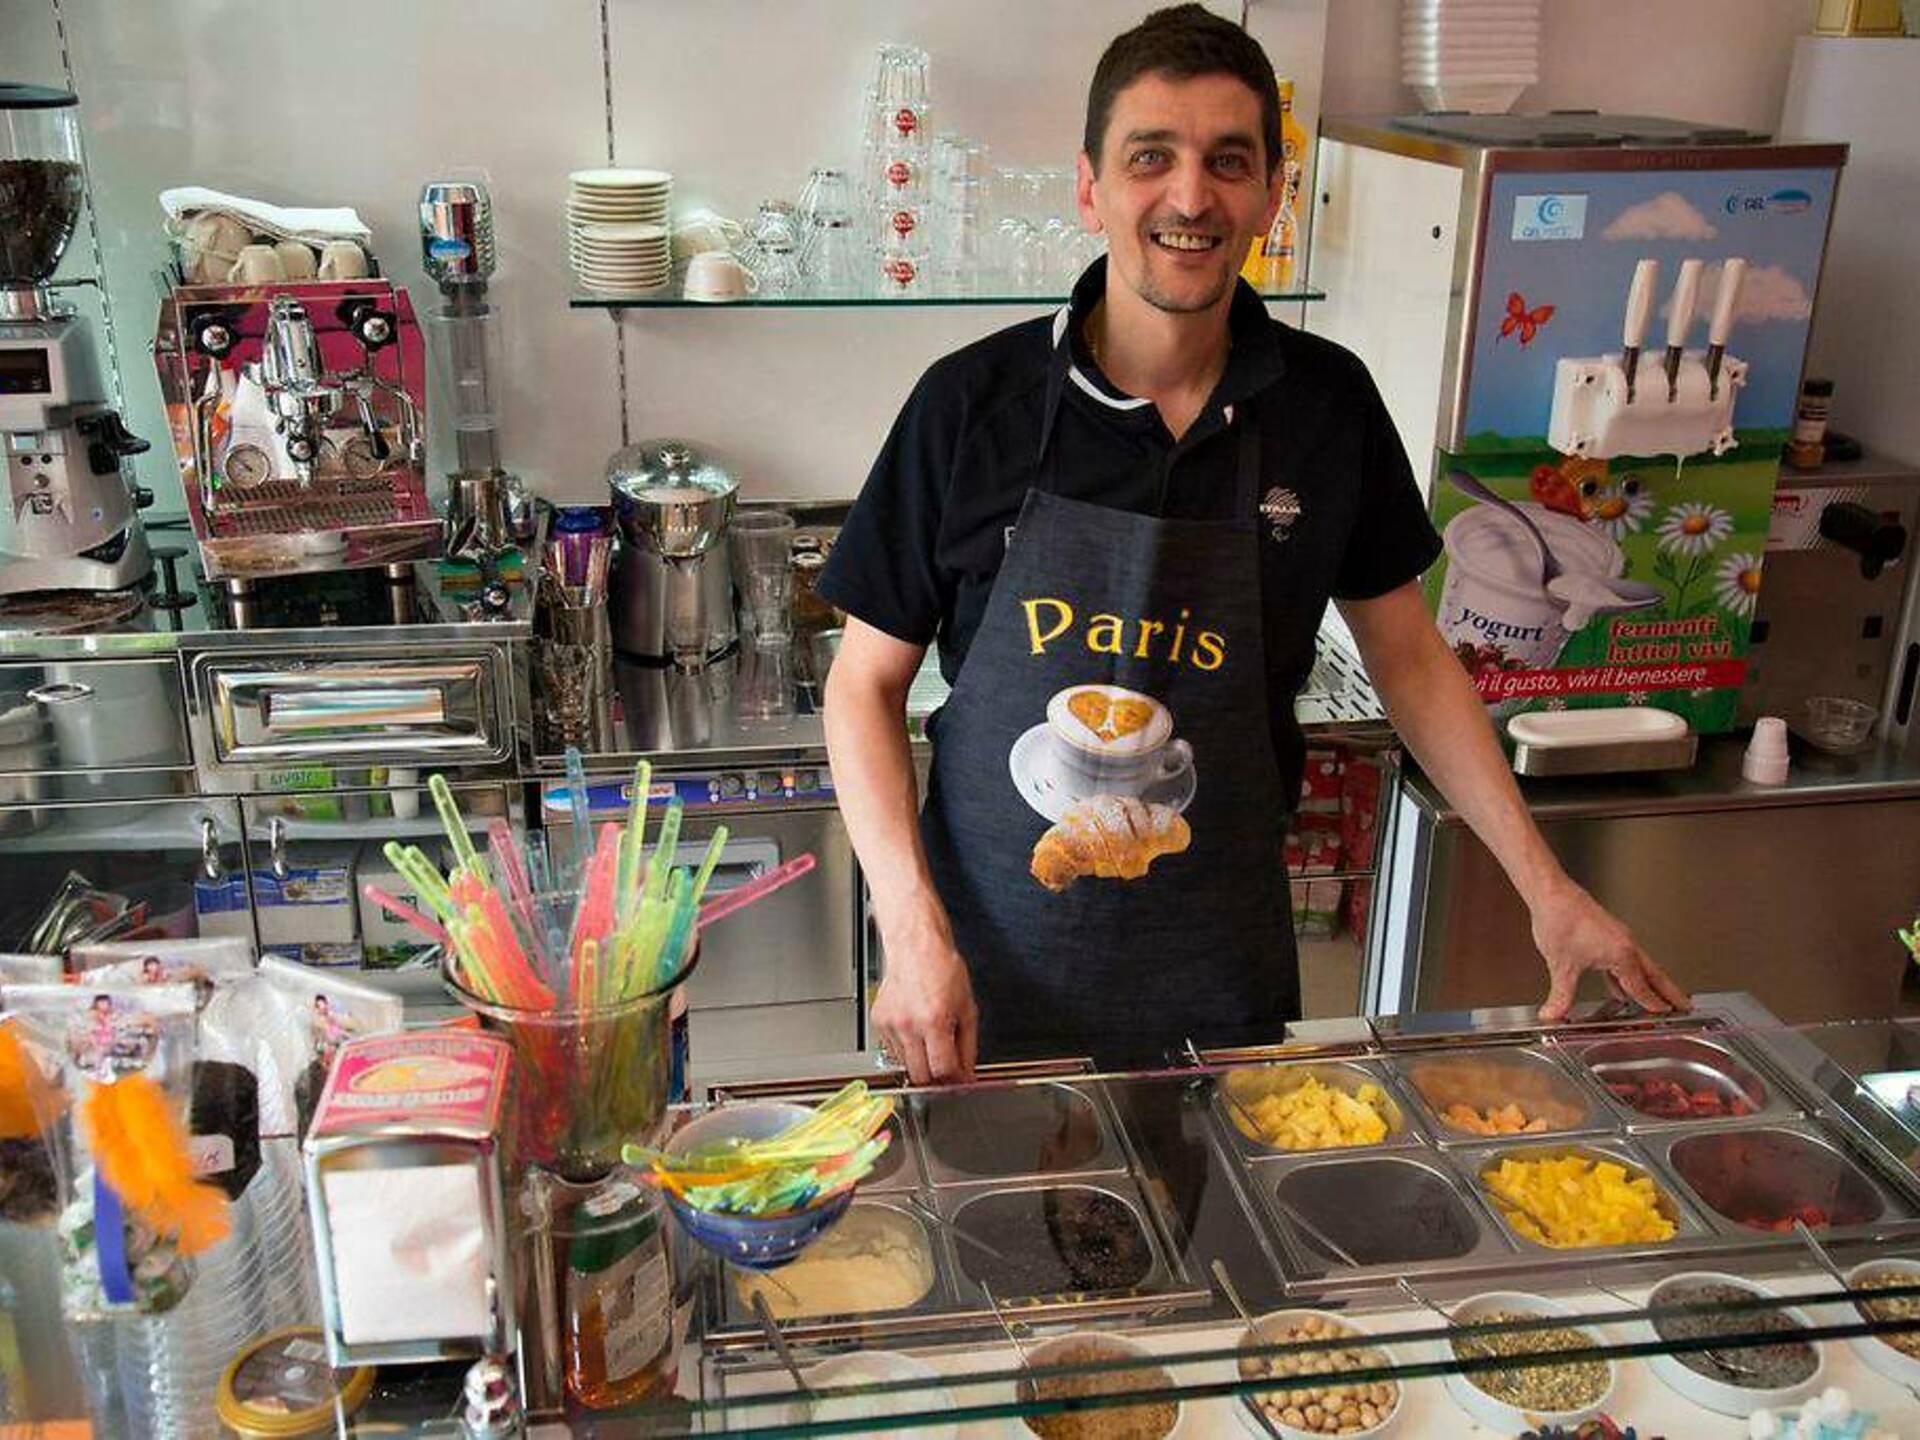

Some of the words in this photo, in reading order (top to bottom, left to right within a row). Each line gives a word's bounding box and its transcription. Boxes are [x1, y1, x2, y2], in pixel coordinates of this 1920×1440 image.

[1021, 597, 1226, 671] Paris
[1453, 606, 1544, 641] yogurt
[1687, 637, 1731, 658] vivi
[1488, 673, 1503, 691] il
[1503, 674, 1562, 696] gusto,
[1567, 669, 1599, 688] vivi
[1600, 667, 1614, 686] il
[1615, 666, 1706, 686] benessere
